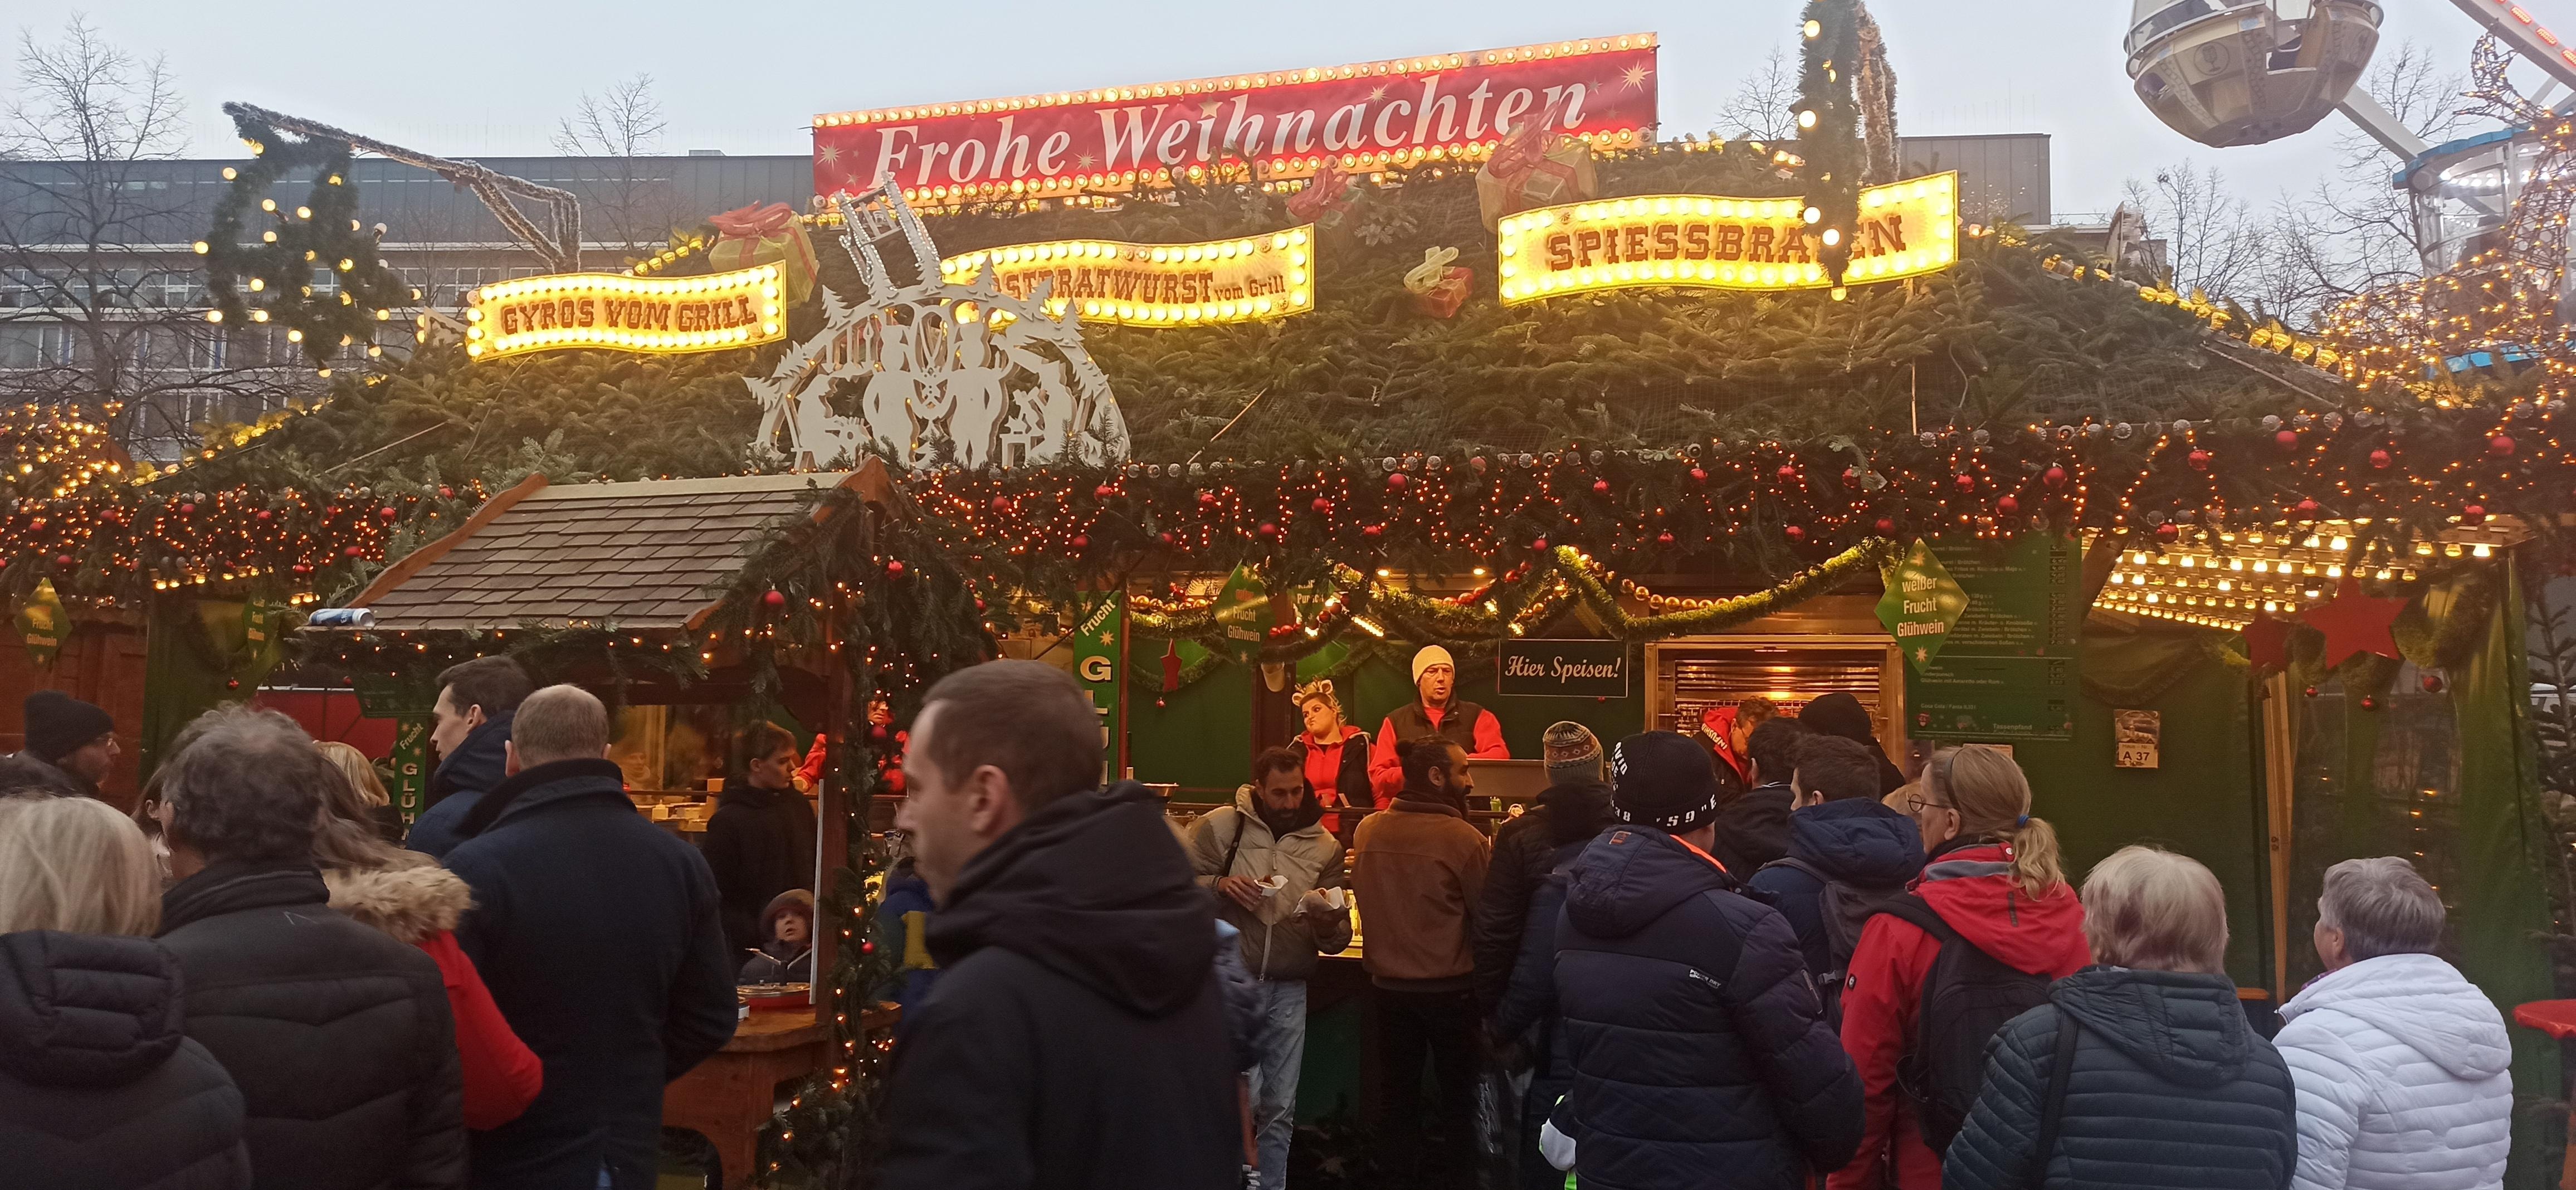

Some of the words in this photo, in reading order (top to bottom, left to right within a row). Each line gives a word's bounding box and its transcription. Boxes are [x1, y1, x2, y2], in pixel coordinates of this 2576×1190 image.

[866, 115, 1070, 189] Frohe
[1094, 74, 1588, 172] Weihnachten
[1549, 215, 1906, 271] SPIESSBRAN
[1214, 285, 1244, 301] vom
[1249, 275, 1286, 298] Grill
[502, 298, 594, 335] GYROS
[604, 298, 671, 331] VOM
[678, 296, 758, 333] GRILL
[1901, 575, 1938, 593] weißer
[1080, 599, 1116, 637] Frucht
[1233, 606, 1256, 622] Frucht
[1904, 597, 1938, 614] Frucht
[1227, 625, 1260, 642] Glühwein
[1897, 618, 1944, 637] Glühwein
[1505, 655, 1545, 676] Hier
[1550, 656, 1621, 684] Speisen!
[399, 723, 425, 750] Frucht
[2123, 750, 2133, 760] A
[2136, 752, 2150, 761] 37
